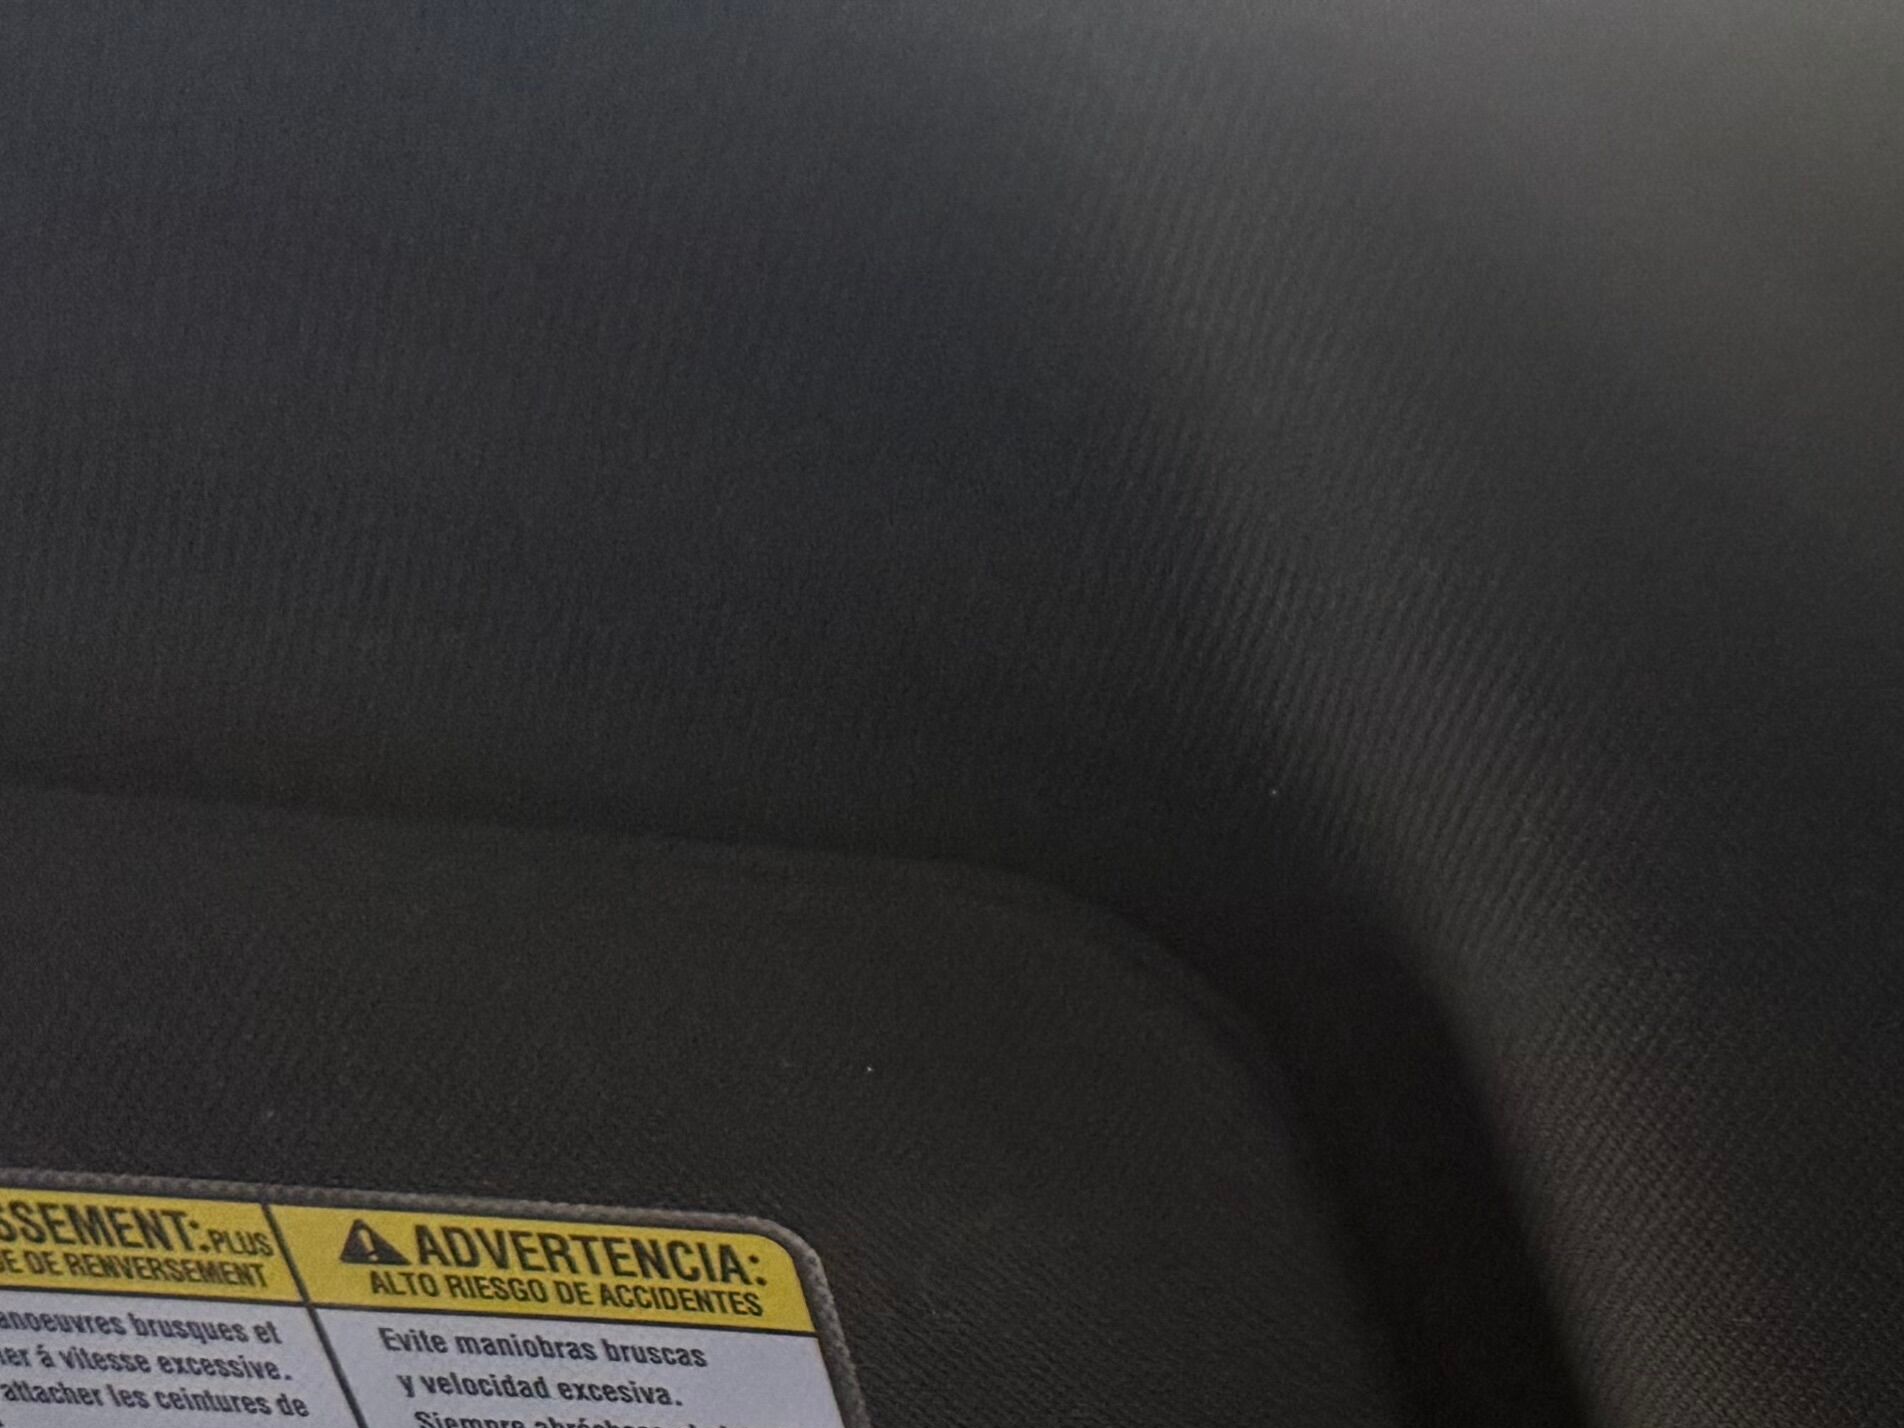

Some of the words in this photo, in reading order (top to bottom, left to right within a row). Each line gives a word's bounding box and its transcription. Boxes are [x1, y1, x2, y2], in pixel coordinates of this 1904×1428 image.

[208, 1229, 274, 1257] PLUS
[412, 1223, 768, 1287] ADVERTENCIA:
[23, 1251, 64, 1277] DE
[63, 1253, 268, 1288] RENVERSEMENT
[369, 1270, 438, 1298] ALTO
[448, 1275, 547, 1304] RIESGO
[553, 1280, 591, 1305] DE
[600, 1283, 763, 1317] ACCIDENTES
[127, 1313, 249, 1344] brusques
[253, 1321, 283, 1344] et
[59, 1346, 151, 1374] vitesse
[158, 1355, 293, 1382] excessive.
[378, 1327, 448, 1355] Evite
[456, 1332, 598, 1361] maniobras
[601, 1338, 708, 1368] bruscas
[0, 1380, 104, 1407] attacher
[107, 1383, 151, 1409] les
[154, 1387, 273, 1416] ceintures
[276, 1393, 309, 1418] de
[398, 1374, 415, 1399] y
[421, 1372, 550, 1400] velocidad
[557, 1381, 683, 1408] excesiva.
